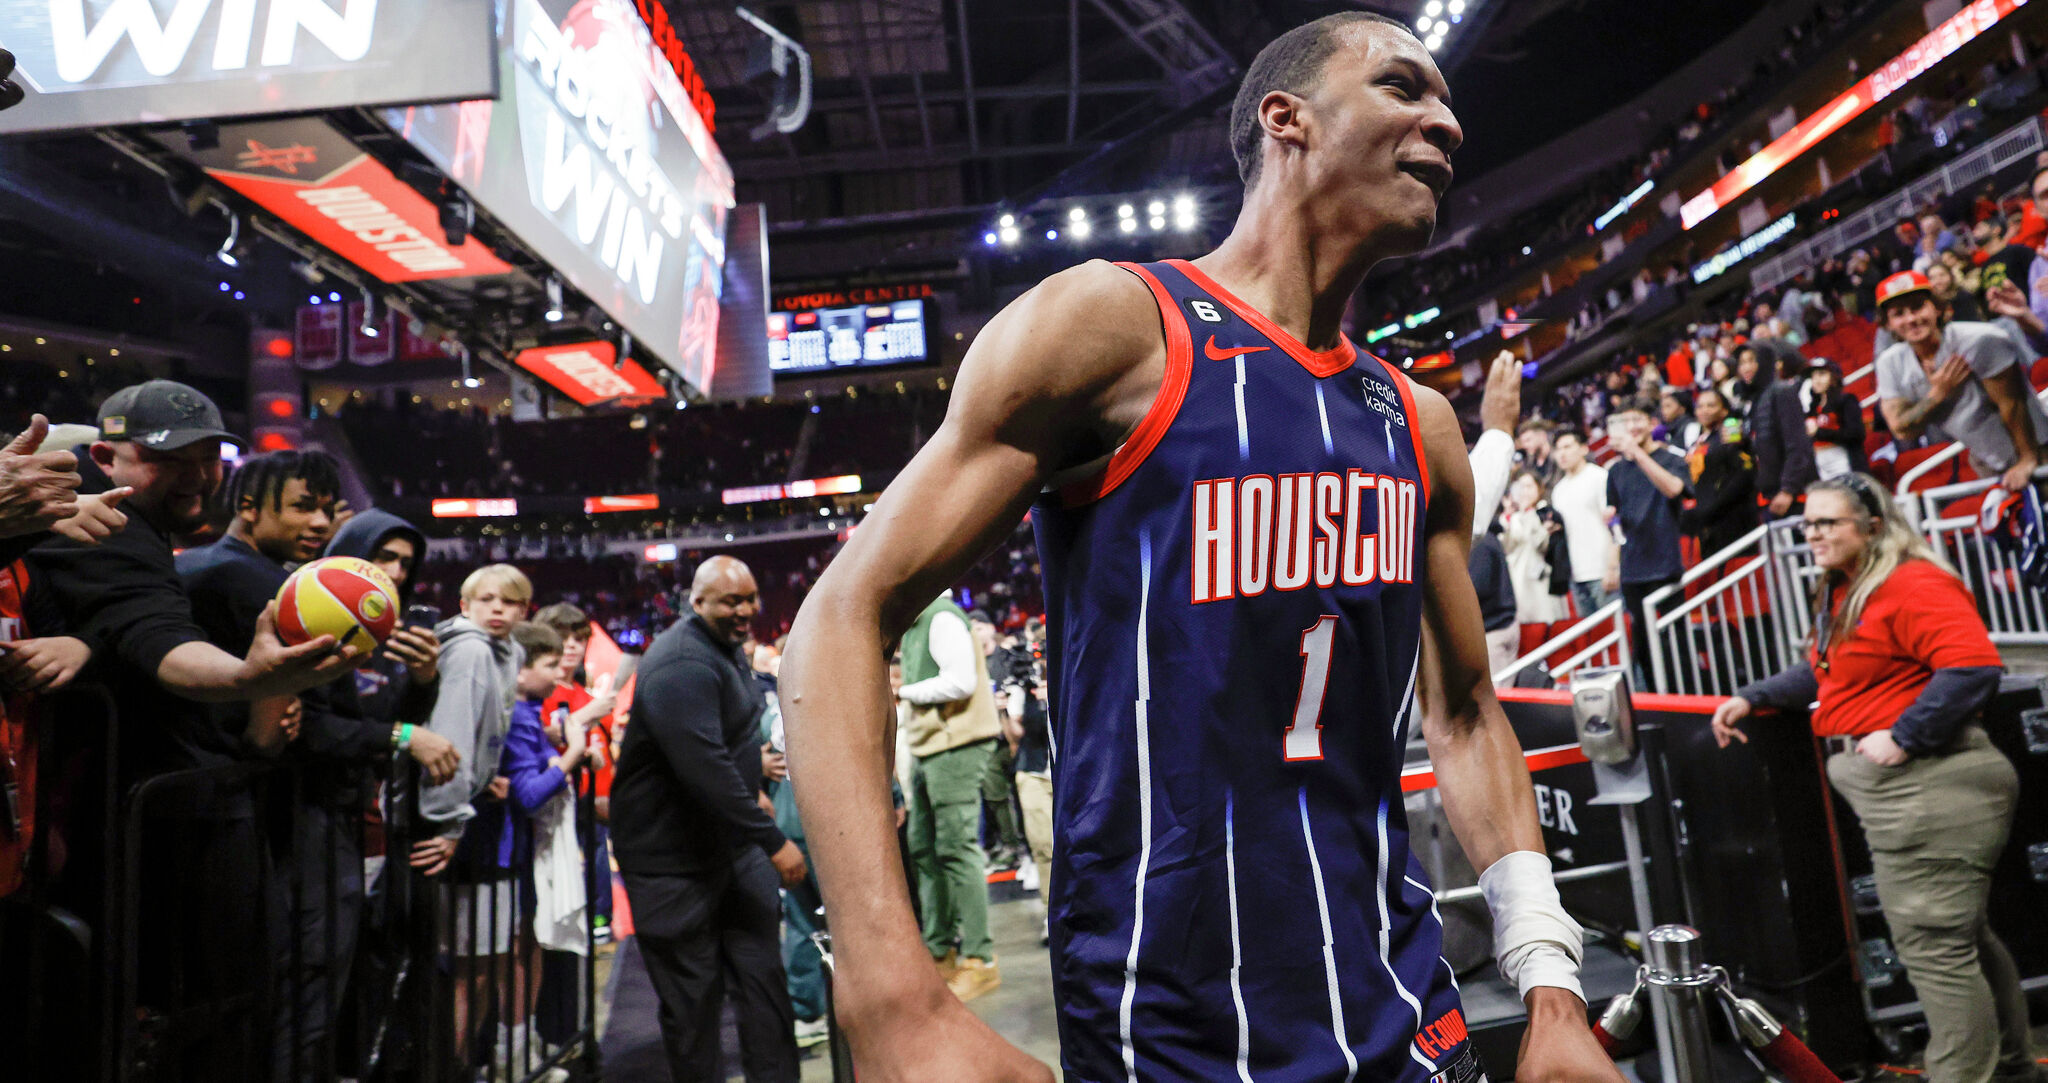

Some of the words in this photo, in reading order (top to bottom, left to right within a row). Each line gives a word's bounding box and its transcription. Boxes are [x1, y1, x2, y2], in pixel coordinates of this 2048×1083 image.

[541, 105, 664, 305] WIN
[1190, 300, 1222, 322] 6
[1361, 376, 1399, 407] credit
[1362, 388, 1406, 427] karma
[1283, 614, 1340, 762] 1
